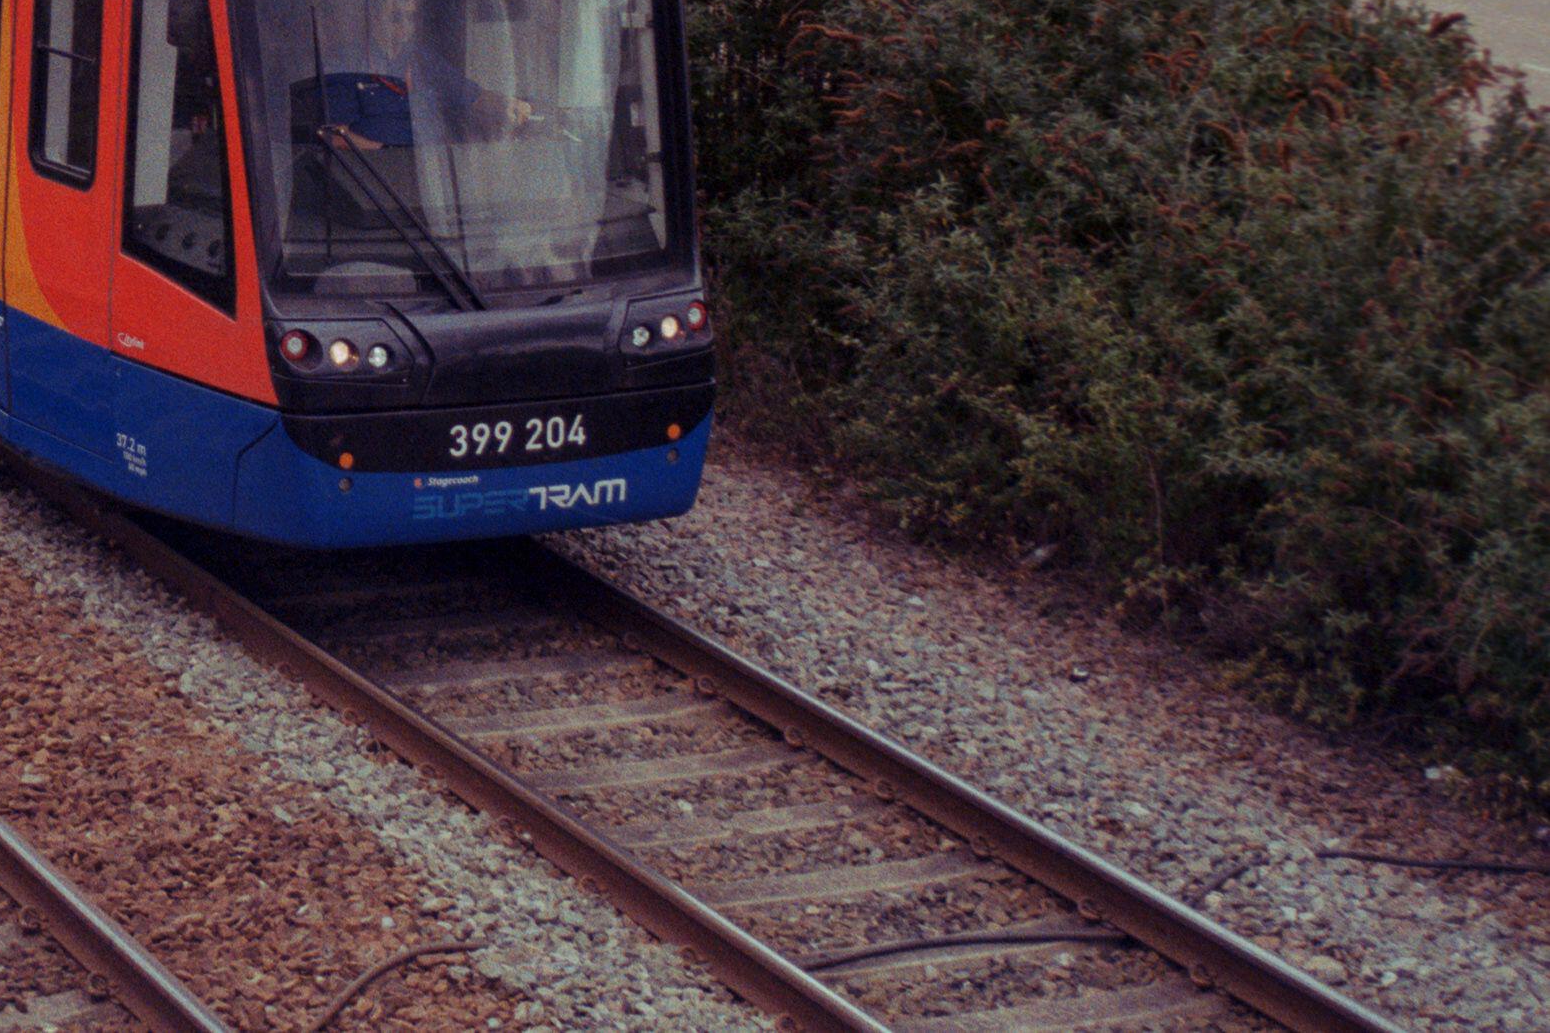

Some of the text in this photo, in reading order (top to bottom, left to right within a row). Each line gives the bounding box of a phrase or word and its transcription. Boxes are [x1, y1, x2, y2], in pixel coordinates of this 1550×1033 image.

[450, 414, 586, 457] 399 204
[427, 475, 479, 488] Stagecoach
